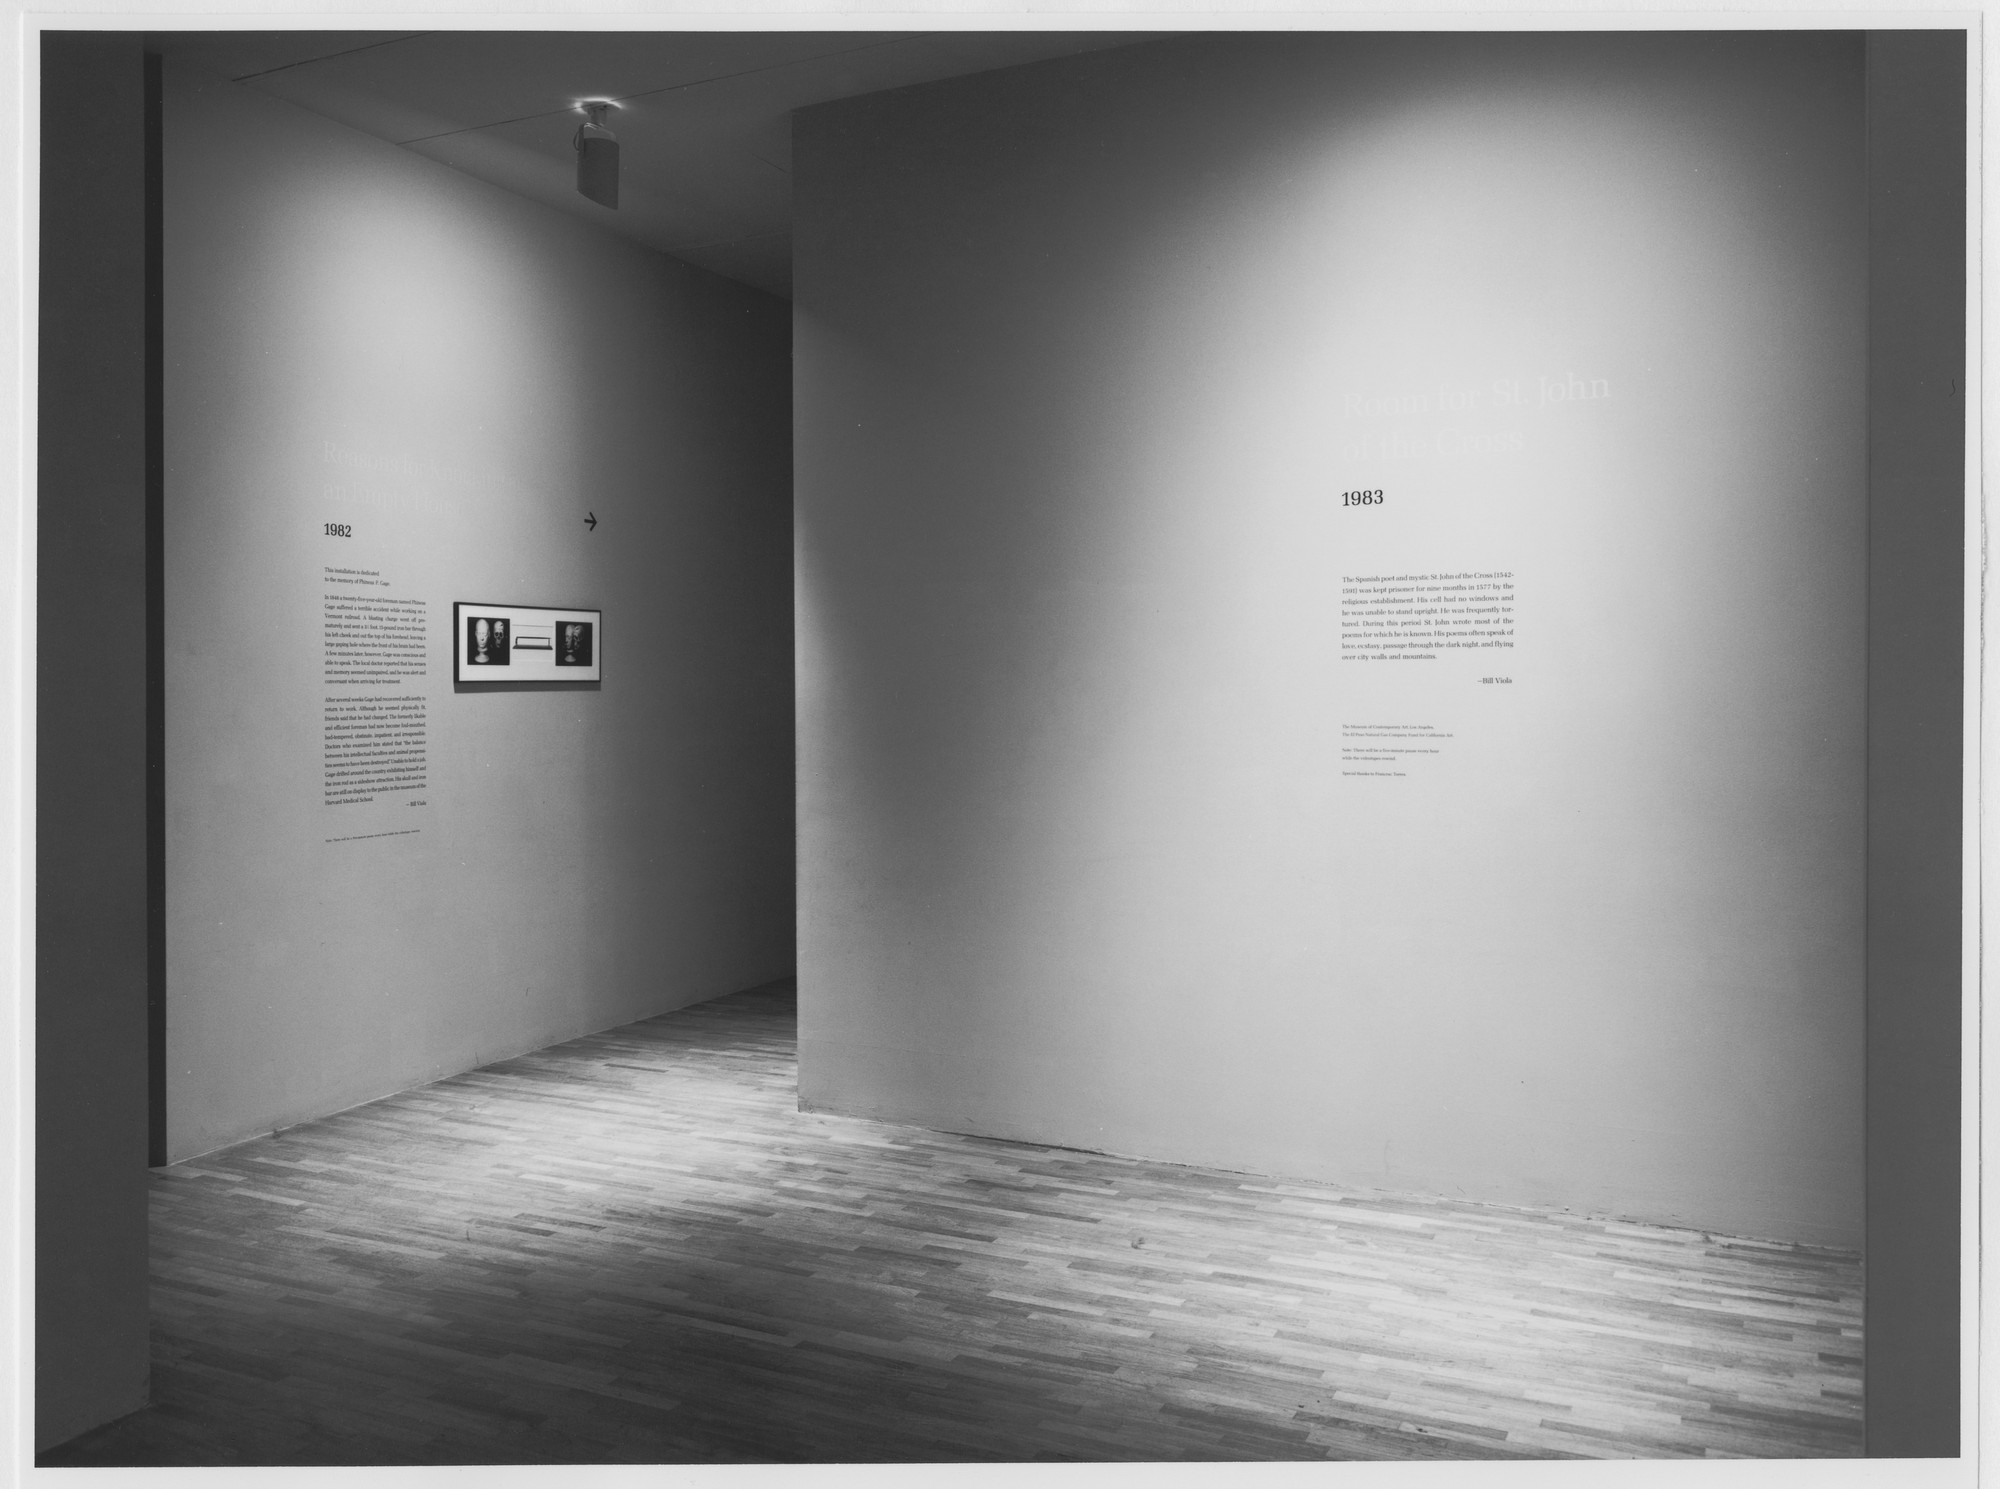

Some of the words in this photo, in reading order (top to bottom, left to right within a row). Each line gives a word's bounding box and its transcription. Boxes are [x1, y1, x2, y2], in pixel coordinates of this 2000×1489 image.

[1342, 392, 1429, 419] Room
[1437, 383, 1480, 411] for
[1492, 378, 1529, 407] St.
[1537, 372, 1611, 409] John
[1342, 433, 1372, 463] of
[1379, 431, 1427, 460] the
[1436, 428, 1525, 456] Cross
[1341, 489, 1384, 506] 1983
[324, 523, 352, 537] 1982
[1355, 575, 1381, 584] Spanish
[1381, 575, 1395, 584] poet
[1409, 574, 1429, 583] mystic
[1343, 586, 1358, 595] 1591)
[1373, 586, 1387, 595] kept
[1388, 585, 1415, 594] prisoner
[1493, 583, 1501, 592] by
[1342, 597, 1369, 606] religious
[1466, 606, 1500, 615] frequently
[1363, 619, 1385, 628] During
[1401, 619, 1422, 628] period
[1487, 629, 1506, 638] speak
[1408, 641, 1434, 650] through
[1495, 641, 1514, 649] flying
[1358, 653, 1369, 662] city
